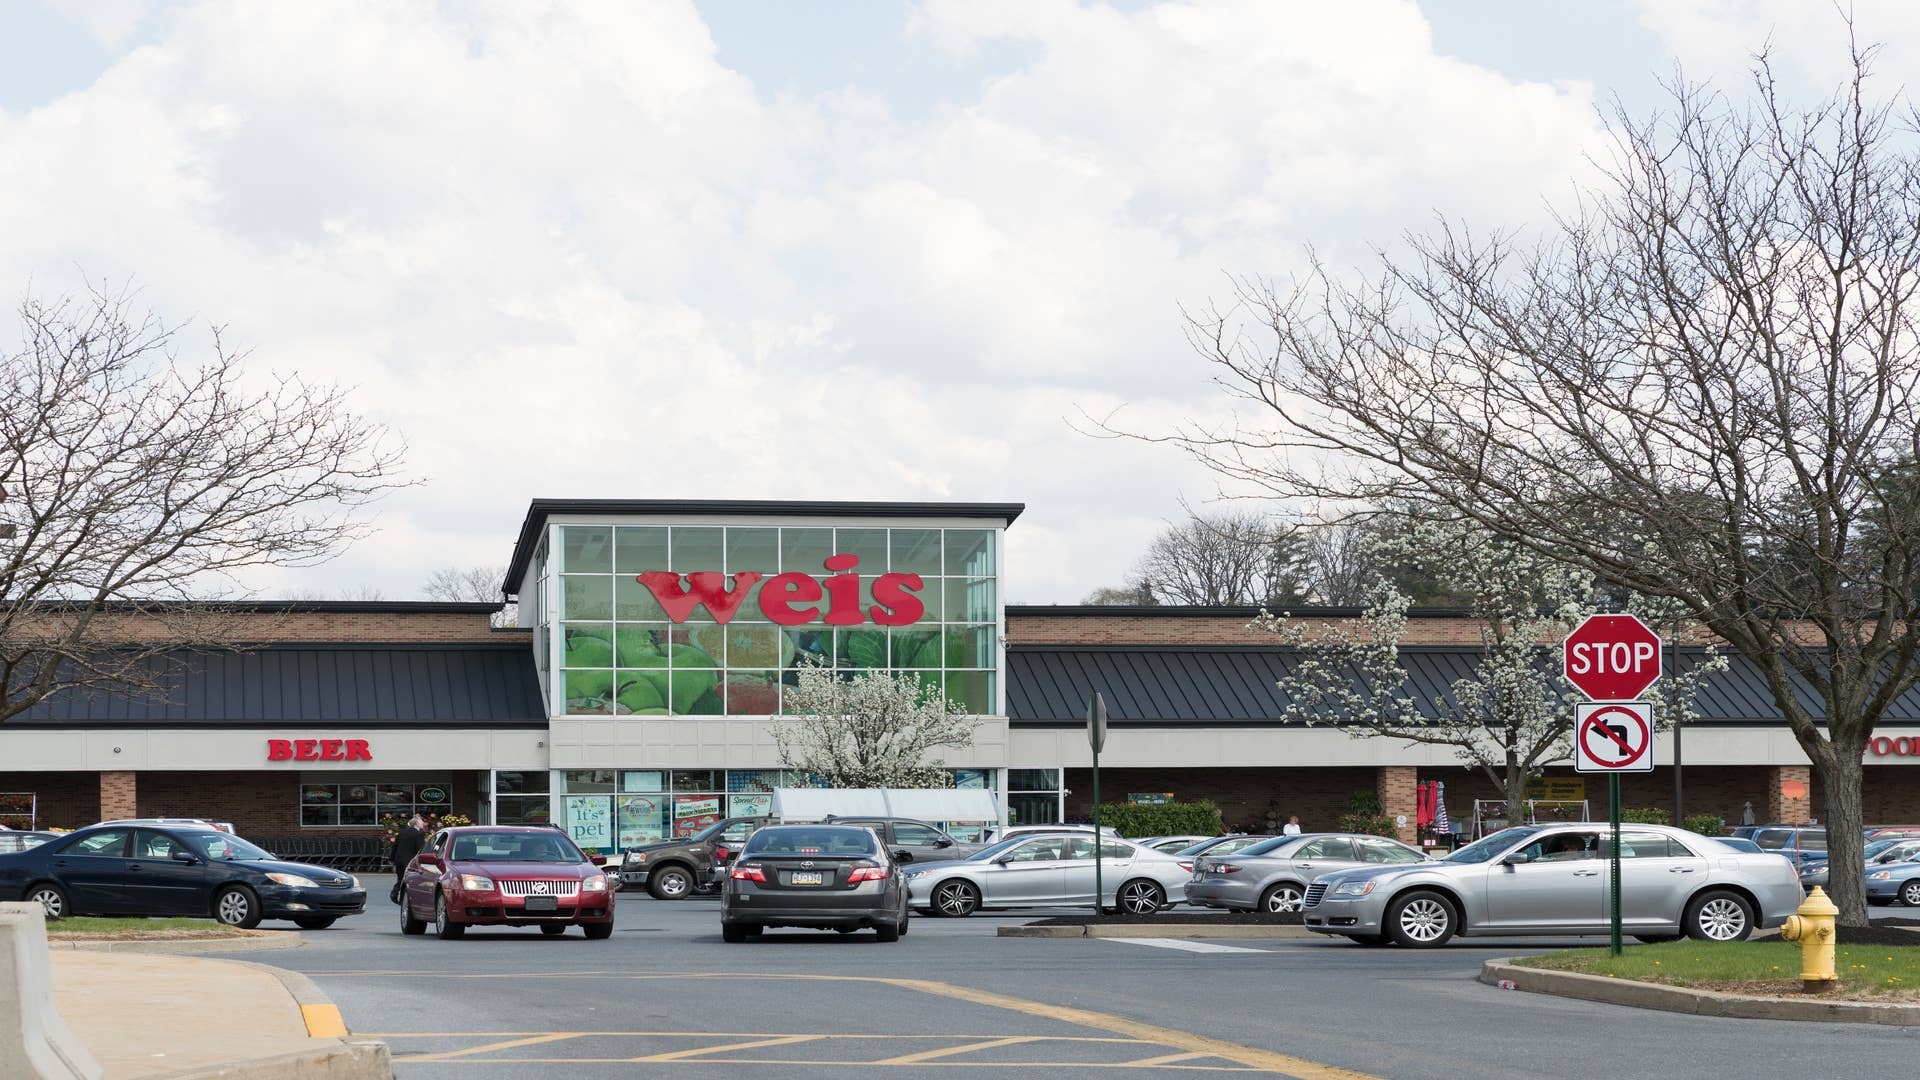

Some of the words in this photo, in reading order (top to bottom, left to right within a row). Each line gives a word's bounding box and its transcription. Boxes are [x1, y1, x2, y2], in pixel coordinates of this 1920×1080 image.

[636, 553, 924, 626] weis
[1571, 641, 1655, 674] STOP
[267, 739, 373, 761] BEER
[1863, 736, 1920, 757] OO
[576, 809, 599, 821] It's
[574, 822, 605, 840] pet
